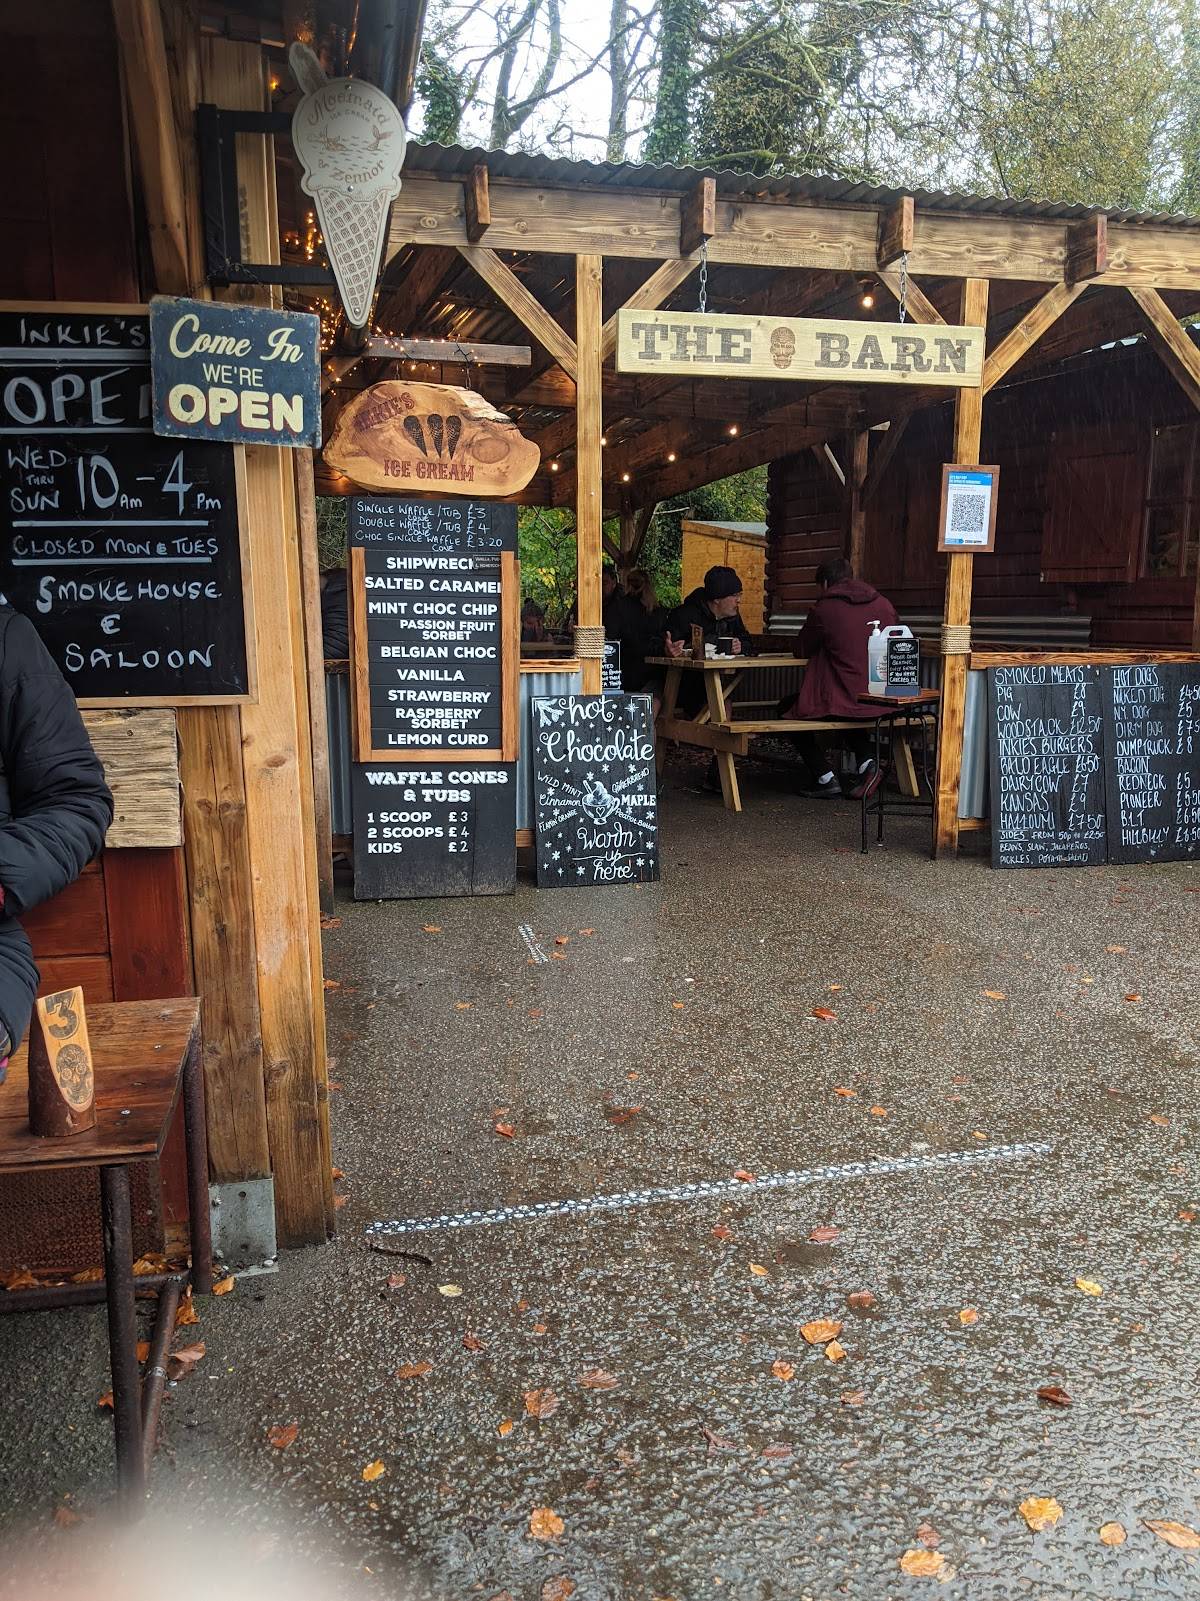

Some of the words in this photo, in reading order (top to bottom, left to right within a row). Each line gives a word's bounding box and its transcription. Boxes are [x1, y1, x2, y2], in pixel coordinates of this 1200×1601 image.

[330, 160, 386, 184] Zennor
[20, 317, 146, 346] INKIE'S
[169, 312, 253, 360] Come
[260, 326, 304, 363] In
[631, 322, 752, 364] THE
[814, 331, 973, 375] BARN
[202, 363, 264, 388] WE'RE
[168, 383, 305, 434] OPEN
[7, 446, 67, 470] WED
[383, 459, 412, 478] ICE
[416, 461, 475, 482] CREAM
[26, 474, 55, 486] THRU
[10, 487, 61, 513] SUN
[356, 501, 395, 515] SINGLE
[399, 504, 435, 517] WAFFLE
[359, 516, 395, 528] DOUBLE
[399, 519, 433, 531] WAFFLE
[13, 535, 95, 556] CLOSED
[105, 538, 151, 555] MON
[172, 537, 219, 555] TUES
[354, 530, 383, 541] CHOC
[387, 532, 423, 544] SINGLE
[427, 534, 462, 546] WAFFLE
[431, 544, 455, 553] CONE
[364, 576, 425, 590] SALTED
[36, 574, 134, 614] SMOKE
[138, 579, 223, 601] HOUSE
[368, 602, 408, 615] MINT
[413, 602, 457, 615] CHOC
[461, 603, 498, 616] CHIP
[399, 619, 455, 631] PASSION
[459, 621, 496, 632] FRUIT
[422, 630, 473, 641] SORBET
[65, 642, 217, 673] SALOON
[380, 645, 449, 659] BELGIAN
[453, 646, 497, 659] CHOC
[396, 669, 465, 682] VANILLA
[994, 666, 1046, 685] SMOKED
[1050, 665, 1084, 684] MEATS
[1113, 667, 1132, 687] HOT
[1135, 666, 1159, 686] DOGS
[388, 689, 492, 703] STRAWBERRY
[997, 686, 1014, 702] PIG
[1073, 683, 1087, 700] £8
[1113, 687, 1146, 705] NAKED
[1149, 686, 1165, 702] DOG
[395, 708, 482, 720] RASPBERRY
[558, 694, 615, 724] hot
[996, 703, 1022, 721] COW
[1132, 704, 1152, 720] DOG
[411, 719, 469, 729] SORBET
[997, 717, 1068, 739] WOODSTACK
[1115, 720, 1143, 738] DIRTY
[1146, 720, 1164, 737] DOG
[388, 733, 443, 746] LEMON
[447, 733, 489, 746] CURD
[540, 729, 655, 763] Chocolate
[1041, 735, 1094, 755] BURGERS
[1000, 756, 1031, 775] BALD
[1034, 756, 1070, 775] EAGLE
[1117, 756, 1150, 774] BACON
[365, 771, 444, 786] WAFFLE
[447, 770, 509, 785] CONES
[1118, 773, 1167, 792] REDNECK
[403, 789, 417, 802] &
[421, 789, 471, 803] TUBS
[539, 793, 582, 807] Cinnamon
[620, 794, 657, 807] MAPLE
[1000, 792, 1050, 812] KANSAS
[1120, 790, 1163, 810] PIONEER
[367, 812, 375, 823] 1
[379, 811, 432, 823] SCOOP
[367, 827, 378, 839] 2
[382, 826, 444, 839] SCOOPS
[577, 822, 637, 851] Warm
[1000, 830, 1026, 840] SIDES
[1031, 831, 1055, 840] FROM
[1122, 826, 1170, 847] HILLBILLY
[367, 842, 403, 854] KIDS
[605, 850, 623, 867] up
[44, 990, 79, 1040] 3
